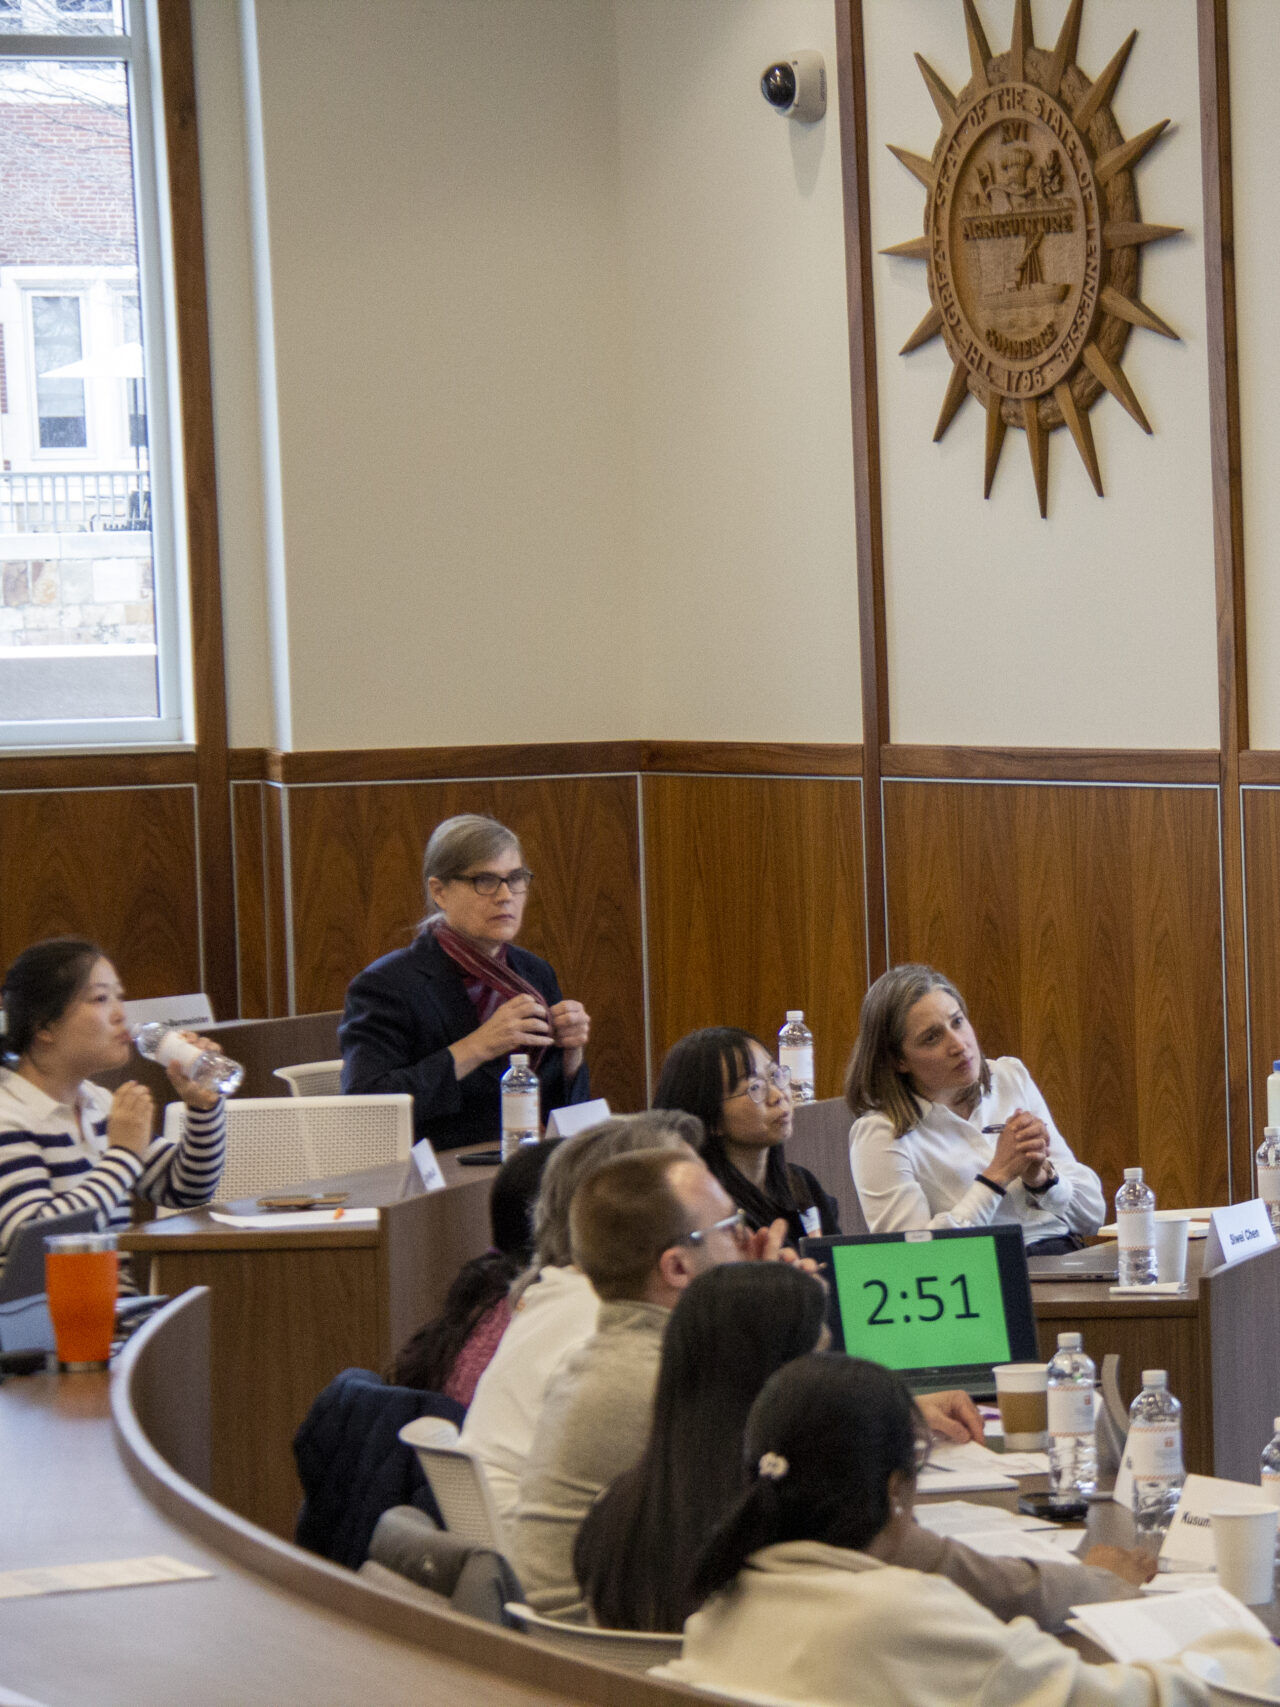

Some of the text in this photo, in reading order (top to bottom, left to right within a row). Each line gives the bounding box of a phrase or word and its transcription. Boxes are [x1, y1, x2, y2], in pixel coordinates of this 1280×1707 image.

[967, 100, 988, 128] OF
[996, 87, 1027, 111] THE
[1001, 120, 1029, 145] XVI
[1032, 95, 1078, 158] STATE
[934, 131, 962, 206] SEAL
[1080, 171, 1094, 201] OF
[962, 214, 1074, 241] AGRICULTURE
[933, 225, 961, 327] GREAT
[1056, 217, 1099, 364] TENNESSEE
[985, 322, 1058, 360] COMMERCE
[1006, 367, 1044, 393] 1796
[1229, 1227, 1260, 1246] Siwei Chen
[863, 1273, 980, 1325] 2:51
